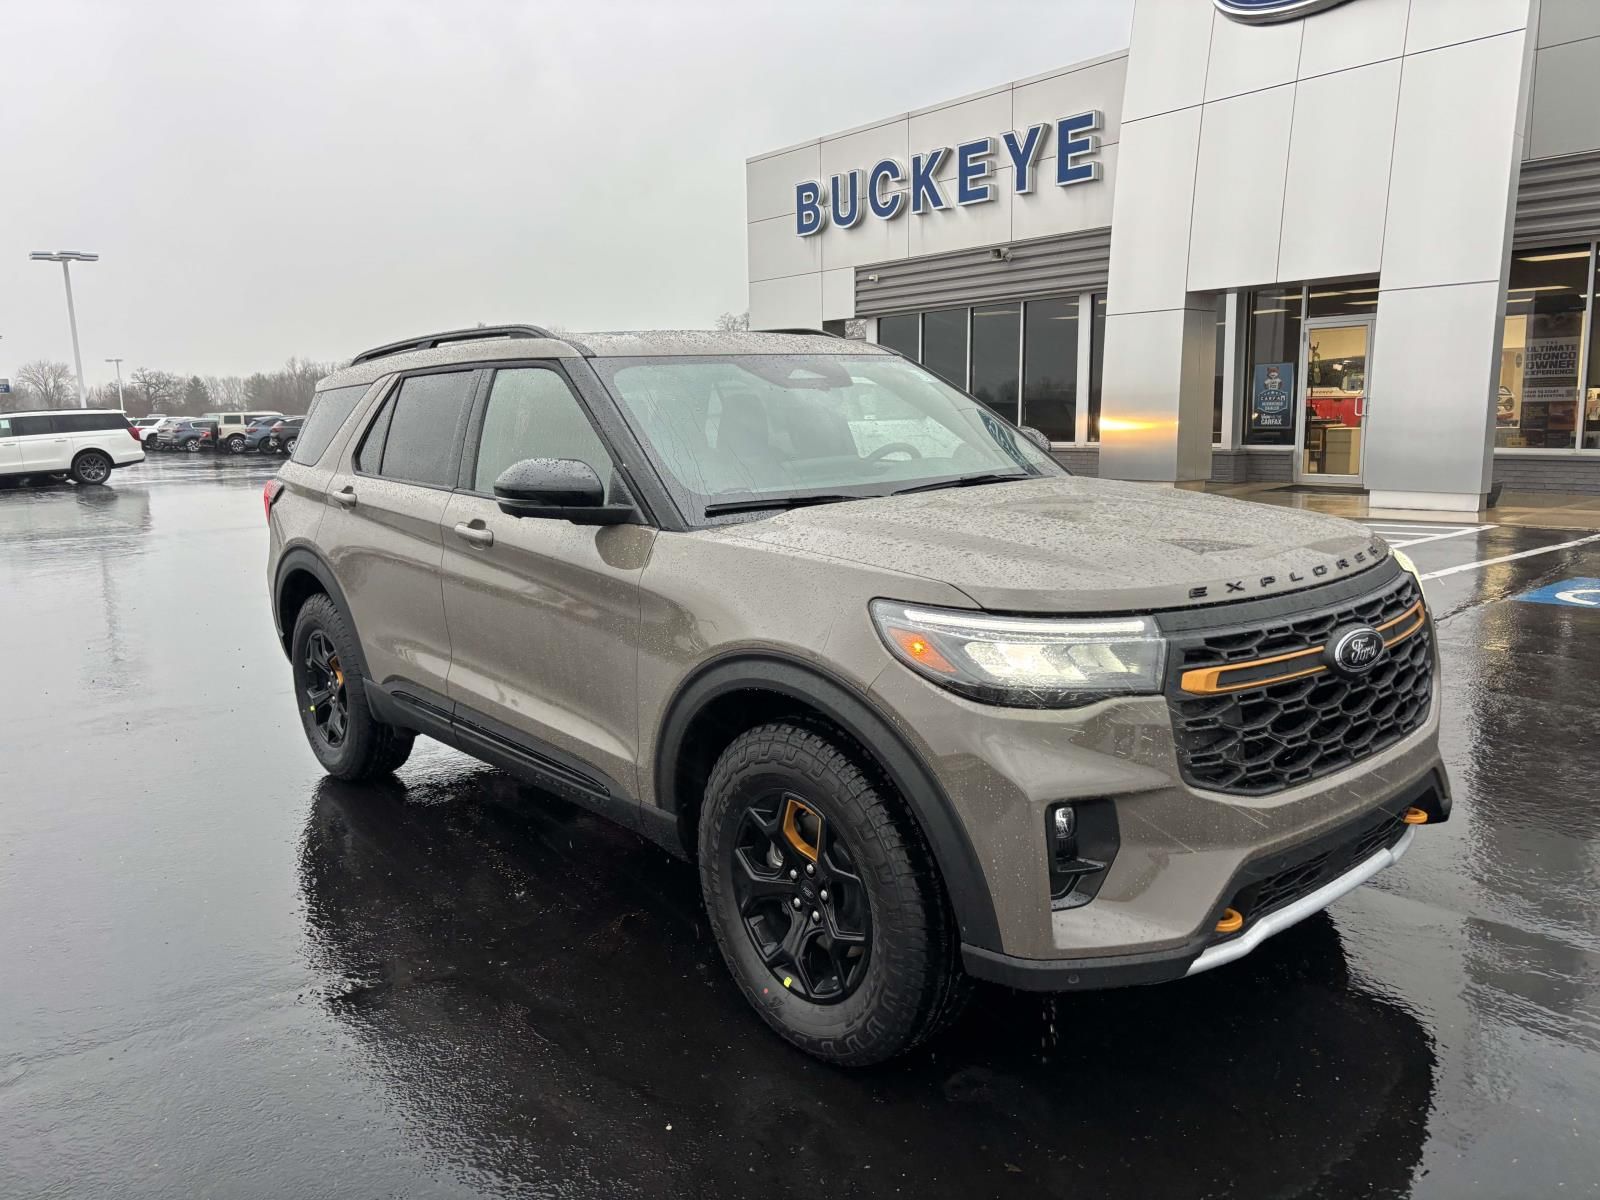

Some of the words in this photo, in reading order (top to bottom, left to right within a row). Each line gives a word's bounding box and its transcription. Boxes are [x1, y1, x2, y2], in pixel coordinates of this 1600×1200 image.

[795, 110, 1102, 237] BUCKEYE
[1525, 352, 1577, 361] BRONCO
[1526, 344, 1577, 353] ULTIMATE
[1525, 360, 1576, 370] OWNER
[1188, 545, 1379, 599] EXPLORER
[1351, 637, 1377, 664] Ford
